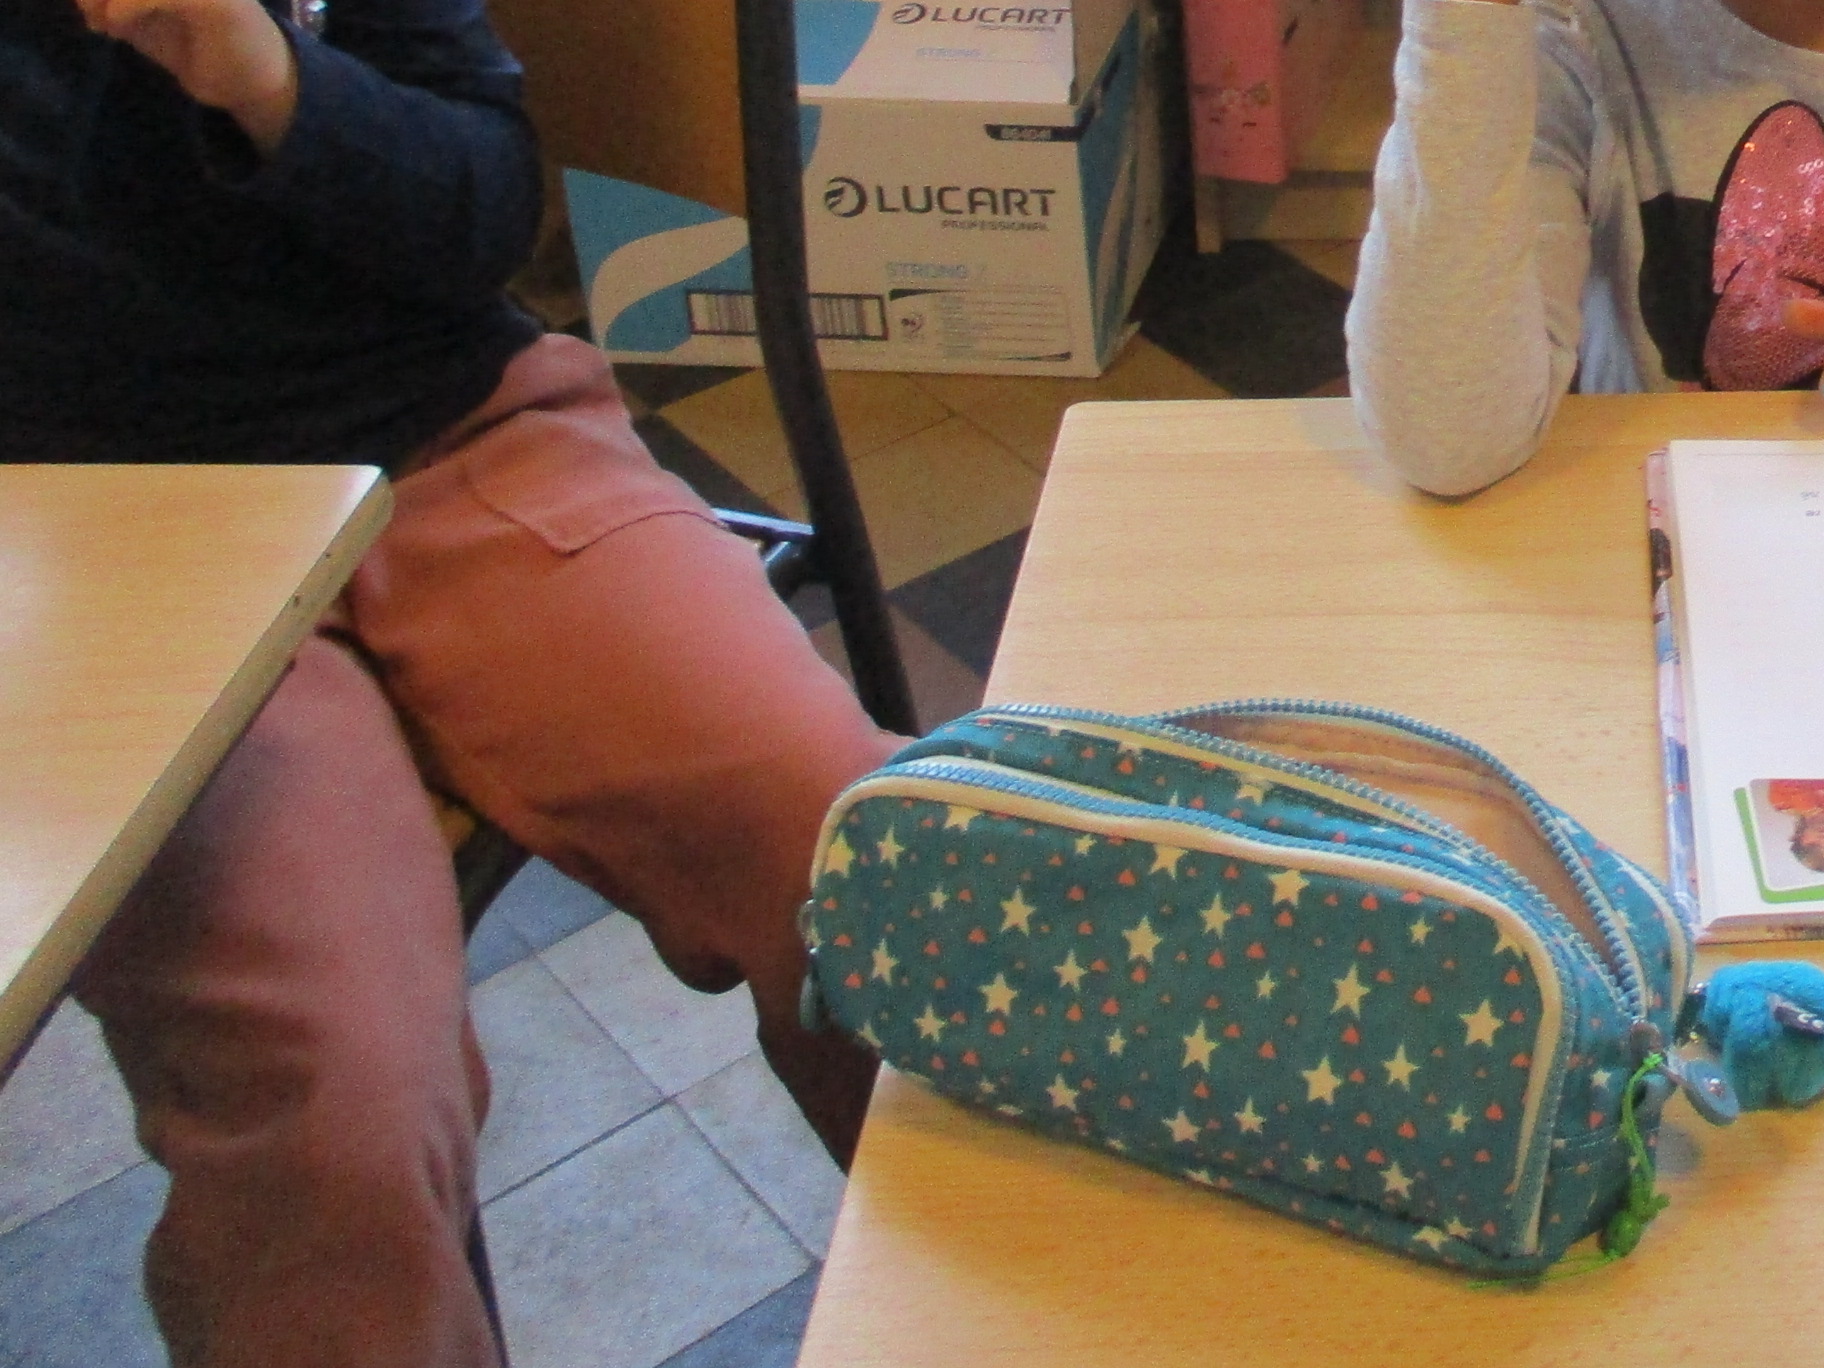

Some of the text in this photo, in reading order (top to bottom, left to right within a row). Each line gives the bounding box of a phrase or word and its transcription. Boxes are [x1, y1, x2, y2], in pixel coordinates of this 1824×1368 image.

[931, 7, 1072, 24] LUCART
[876, 184, 1056, 216] LUCART
[941, 219, 1049, 231] PROFESSIONAL
